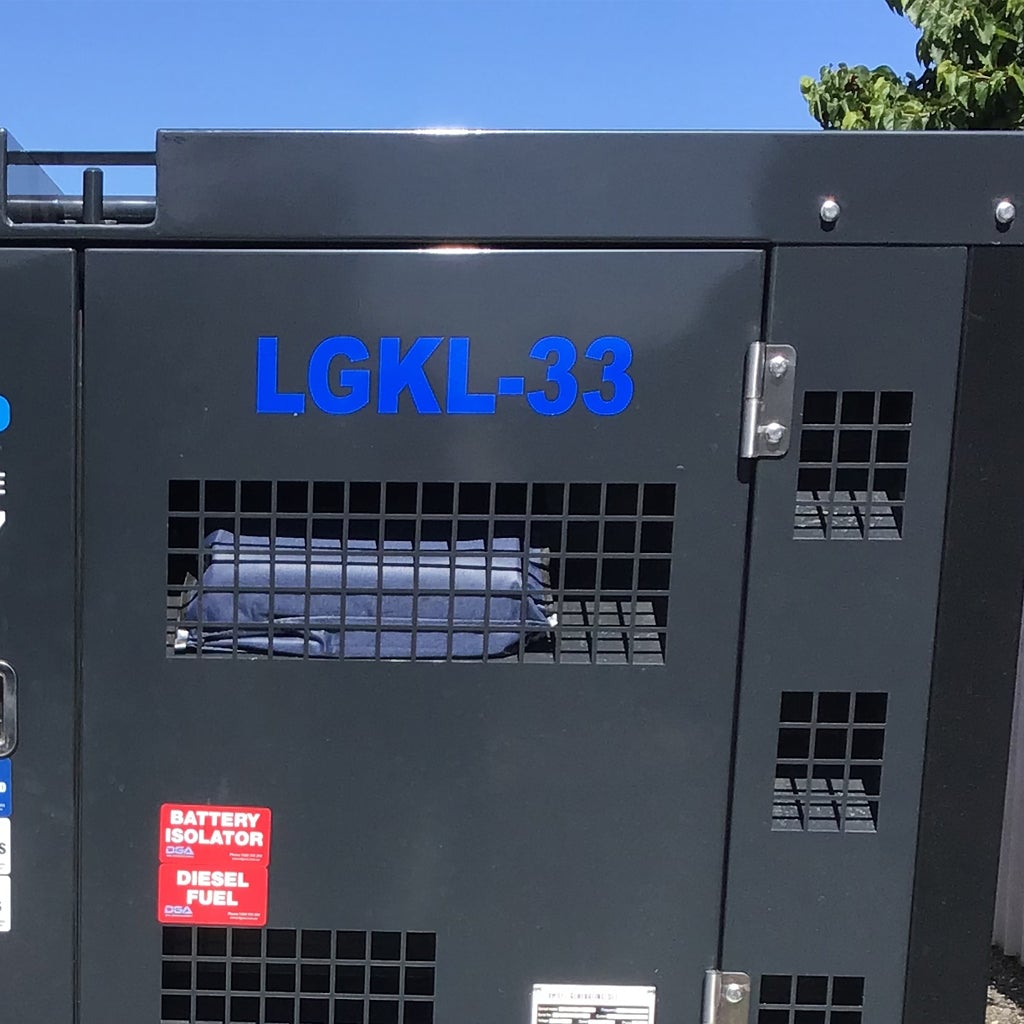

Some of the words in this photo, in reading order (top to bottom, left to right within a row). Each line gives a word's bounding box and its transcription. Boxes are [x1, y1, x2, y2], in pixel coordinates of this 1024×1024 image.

[256, 335, 635, 416] LGKL-33
[170, 809, 261, 828] BATTERY
[165, 828, 264, 847] ISOLATOR
[176, 870, 250, 888] DIESEL
[186, 889, 239, 906] FUEL
